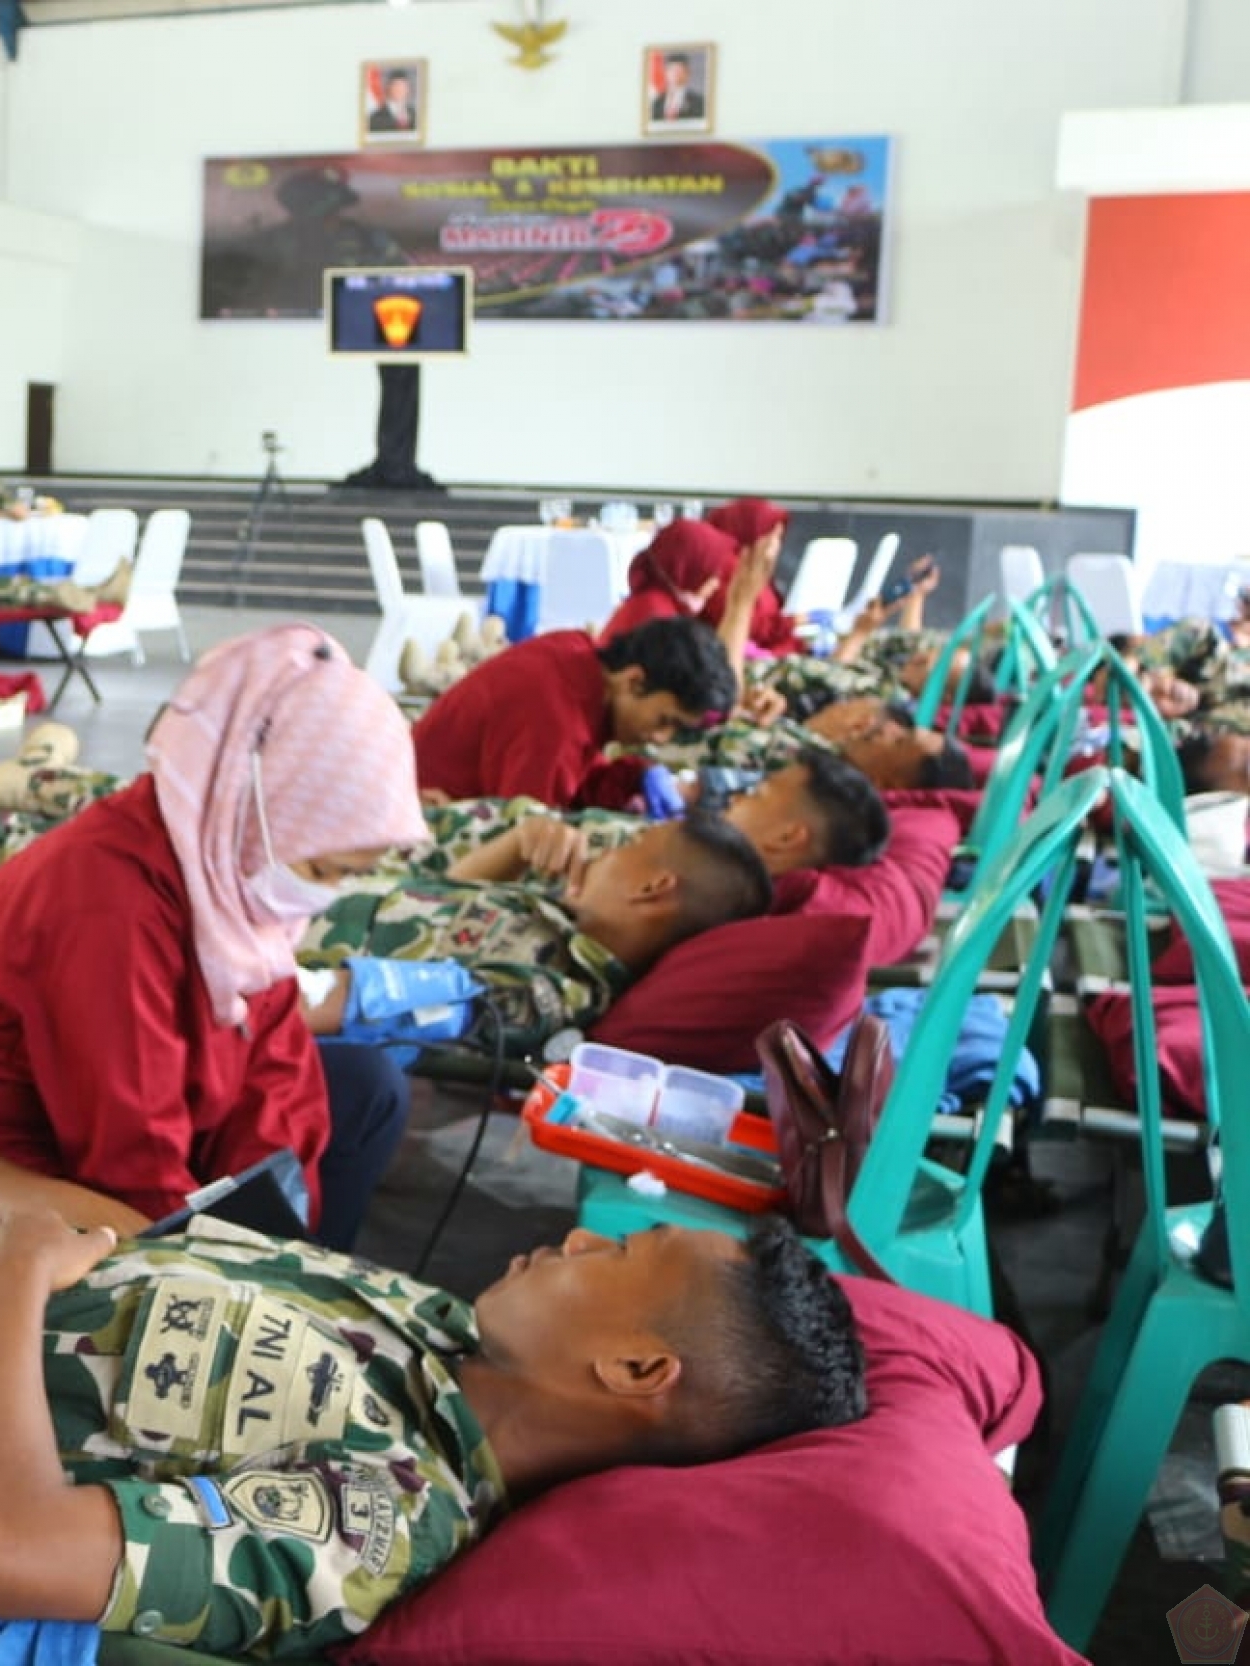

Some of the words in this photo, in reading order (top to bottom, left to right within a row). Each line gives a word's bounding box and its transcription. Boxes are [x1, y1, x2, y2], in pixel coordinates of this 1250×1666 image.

[492, 156, 598, 177] BAKTI
[547, 174, 726, 196] KESEHATAN
[250, 1313, 292, 1361] TNI
[235, 1368, 276, 1436] AL
